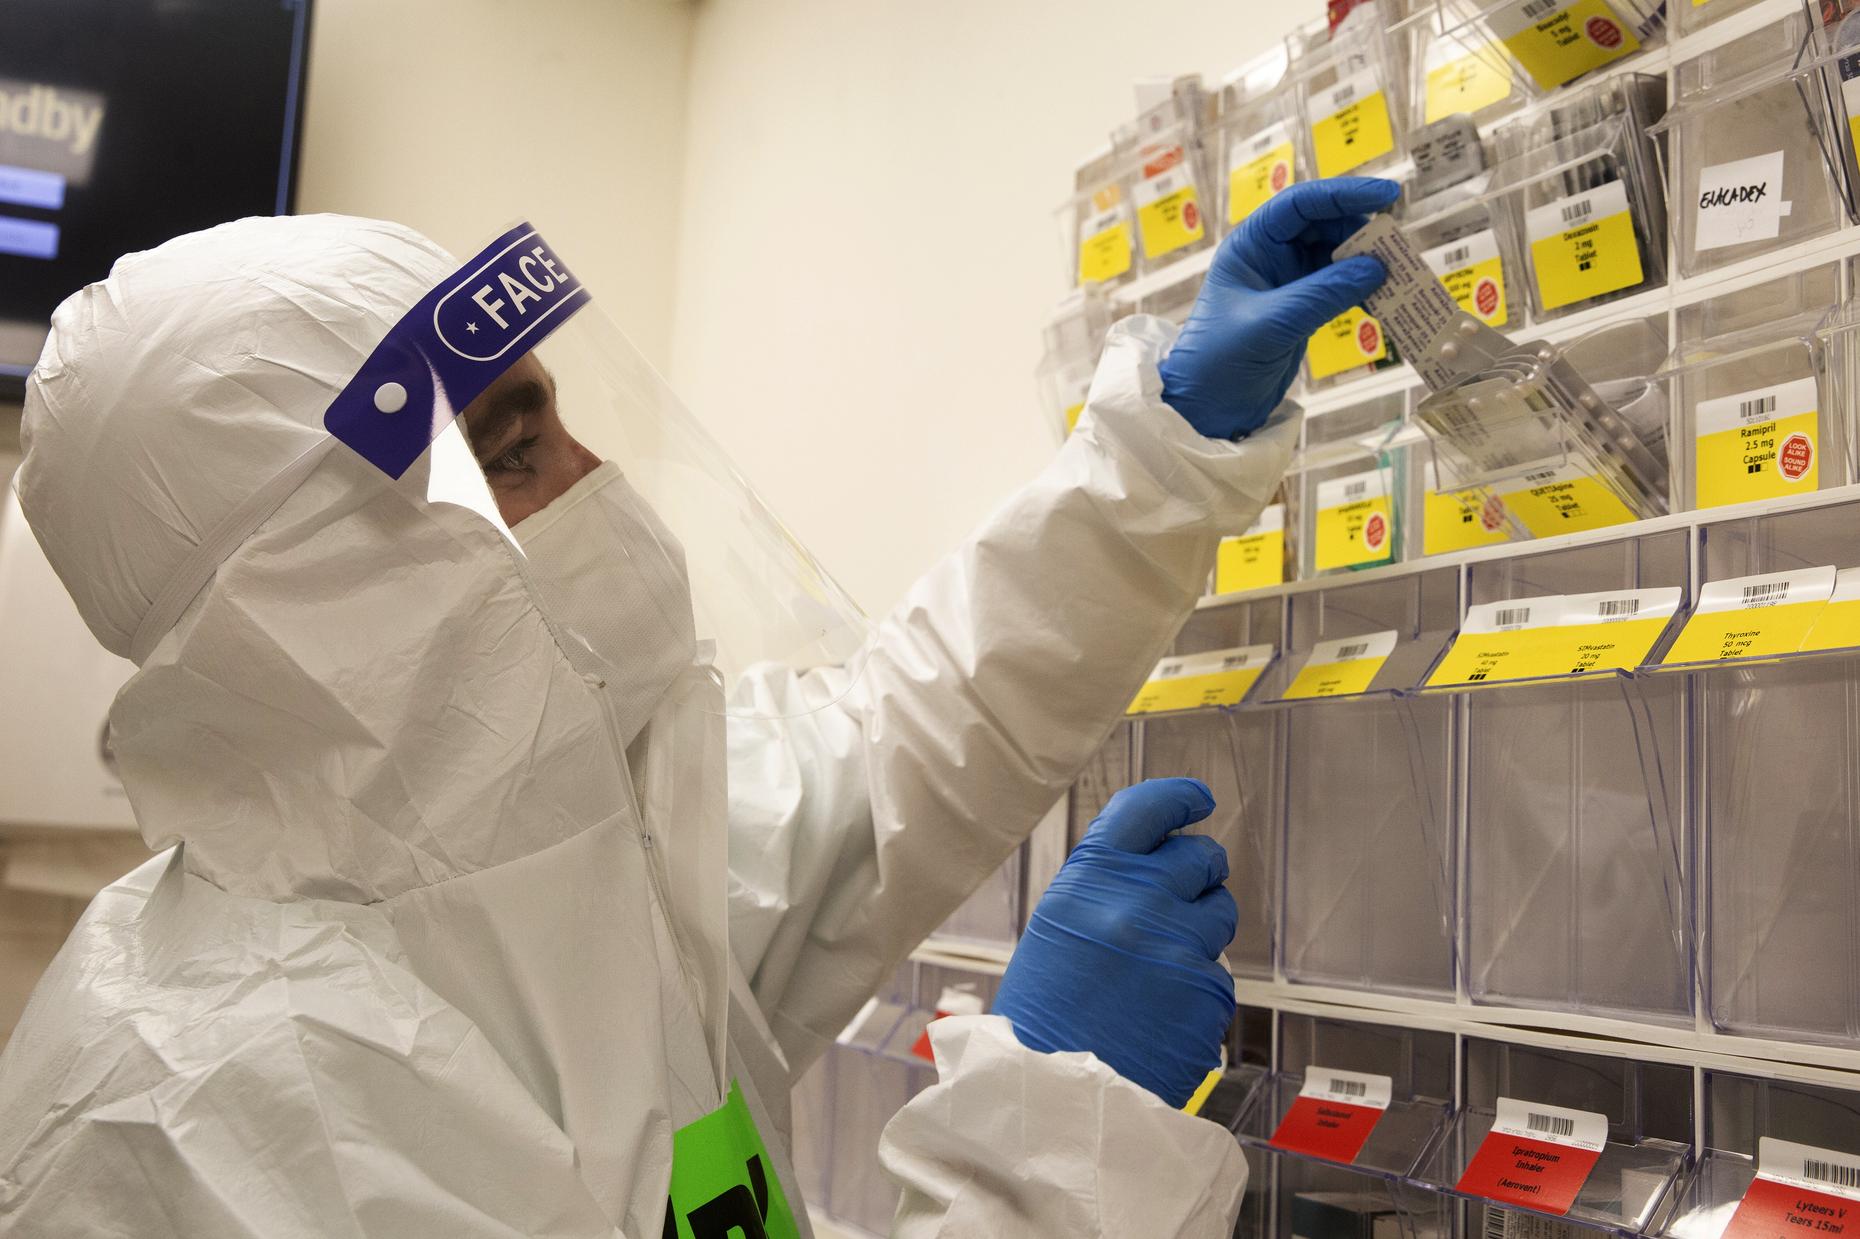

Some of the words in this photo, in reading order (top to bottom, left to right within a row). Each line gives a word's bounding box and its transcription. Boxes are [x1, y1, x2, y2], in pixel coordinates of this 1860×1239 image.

[1575, 250, 1598, 263] Tablet
[471, 246, 569, 330] FACE
[1740, 422, 1776, 438] Ramipril
[1745, 441, 1758, 451] 2.5
[1760, 438, 1774, 449] mg
[1788, 442, 1806, 450] LOOK
[1743, 451, 1776, 465] Capsule
[1786, 448, 1805, 457] ALIKE
[1784, 456, 1806, 466] SOUND
[1784, 463, 1803, 472] ALIKE
[1555, 502, 1580, 513] Tablet
[1723, 629, 1761, 640] Thyroxine
[1736, 639, 1752, 648] mcg
[1719, 648, 1743, 657] Tablet
[1575, 660, 1596, 668] Tablet
[1512, 1145, 1561, 1164] Ipratropium
[1515, 1159, 1545, 1173] Inhaler
[1496, 1177, 1541, 1195] (Aerovent)
[1795, 1199, 1836, 1218] Lyteers
[1838, 1207, 1848, 1219] V
[1785, 1211, 1813, 1228] Tears
[1814, 1219, 1845, 1234] 15ml
